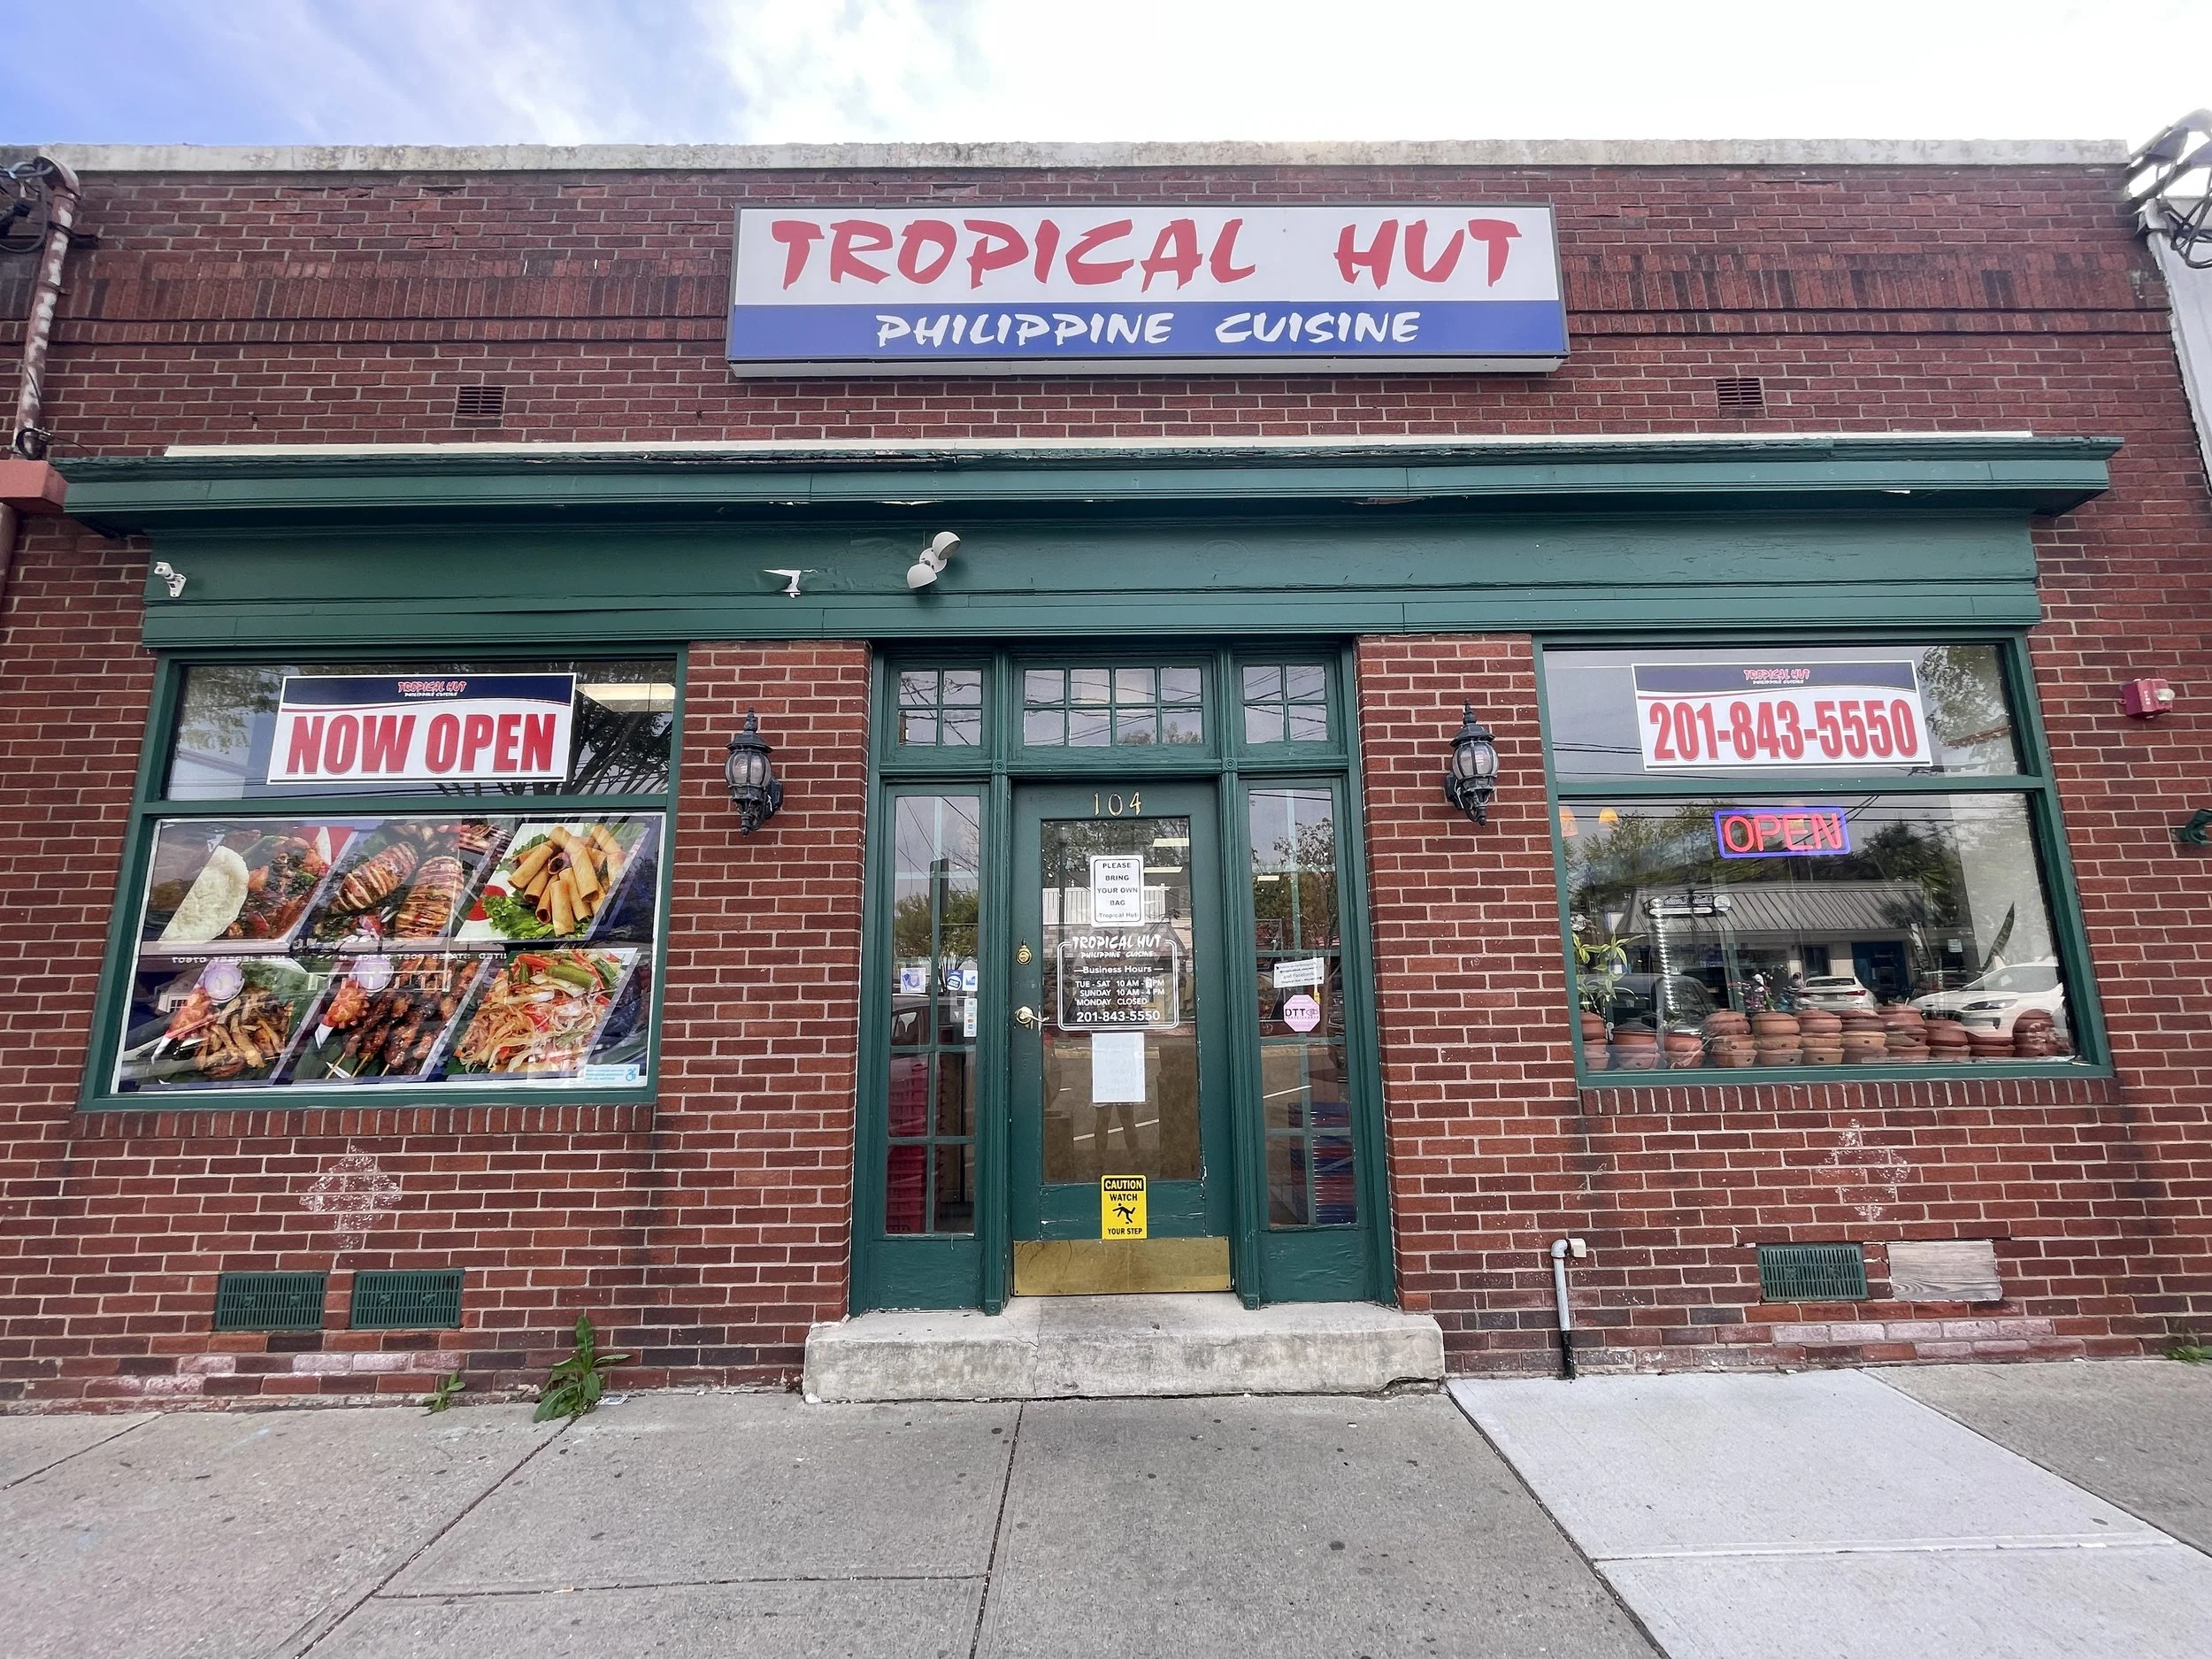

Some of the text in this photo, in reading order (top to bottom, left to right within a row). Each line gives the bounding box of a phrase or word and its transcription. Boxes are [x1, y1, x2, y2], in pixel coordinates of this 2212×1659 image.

[772, 219, 1522, 292] TROPICAL HUT
[876, 311, 1420, 347] PHILIPPINE CUISINE
[398, 680, 467, 693] TROPICAL HUT
[1743, 668, 1810, 680] TROPICAL HUT
[1649, 699, 1918, 761] 201-843-5550
[286, 713, 557, 775] NOW OPEN
[1094, 791, 1141, 816] 104
[1724, 813, 1842, 852] OPEN
[1072, 934, 1161, 950] TROPICAL HUT
[1077, 1010, 1160, 1022] 201-843-5550
[1105, 1180, 1142, 1189] CAUTION
